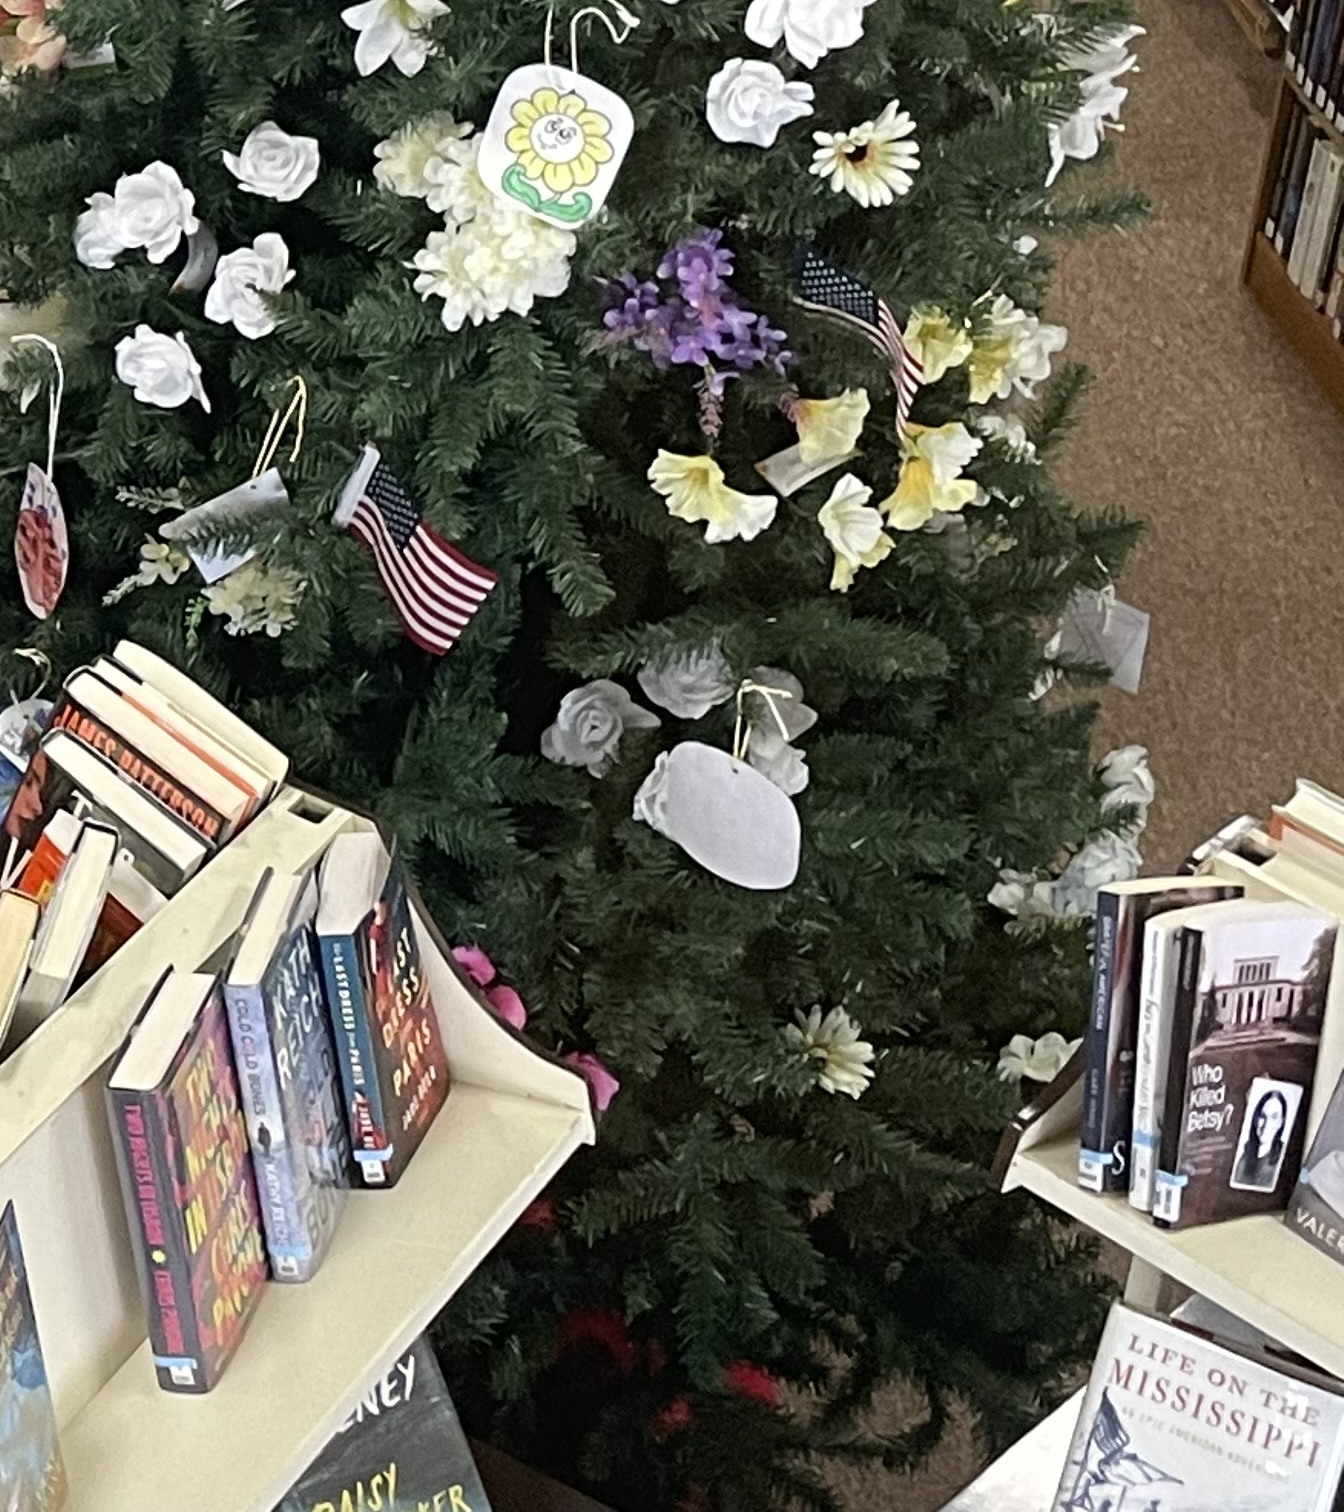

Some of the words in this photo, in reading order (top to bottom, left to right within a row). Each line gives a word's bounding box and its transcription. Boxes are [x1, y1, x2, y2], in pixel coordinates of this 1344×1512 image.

[53, 704, 117, 758] JAMES
[234, 998, 253, 1033] COLD
[248, 1072, 267, 1117] BONES
[276, 972, 323, 1091] REICH
[391, 1017, 432, 1098] PARIS
[1189, 1084, 1227, 1109] Killed
[1191, 1063, 1224, 1087] Who
[1187, 1104, 1234, 1133] Betsy?
[336, 1354, 415, 1433] NEY
[1107, 1357, 1322, 1468] MISSISSIPPI
[1127, 1334, 1197, 1376] LIFE
[1207, 1368, 1250, 1399] ON
[1259, 1389, 1321, 1428] THE
[313, 1462, 397, 1512] AISY
